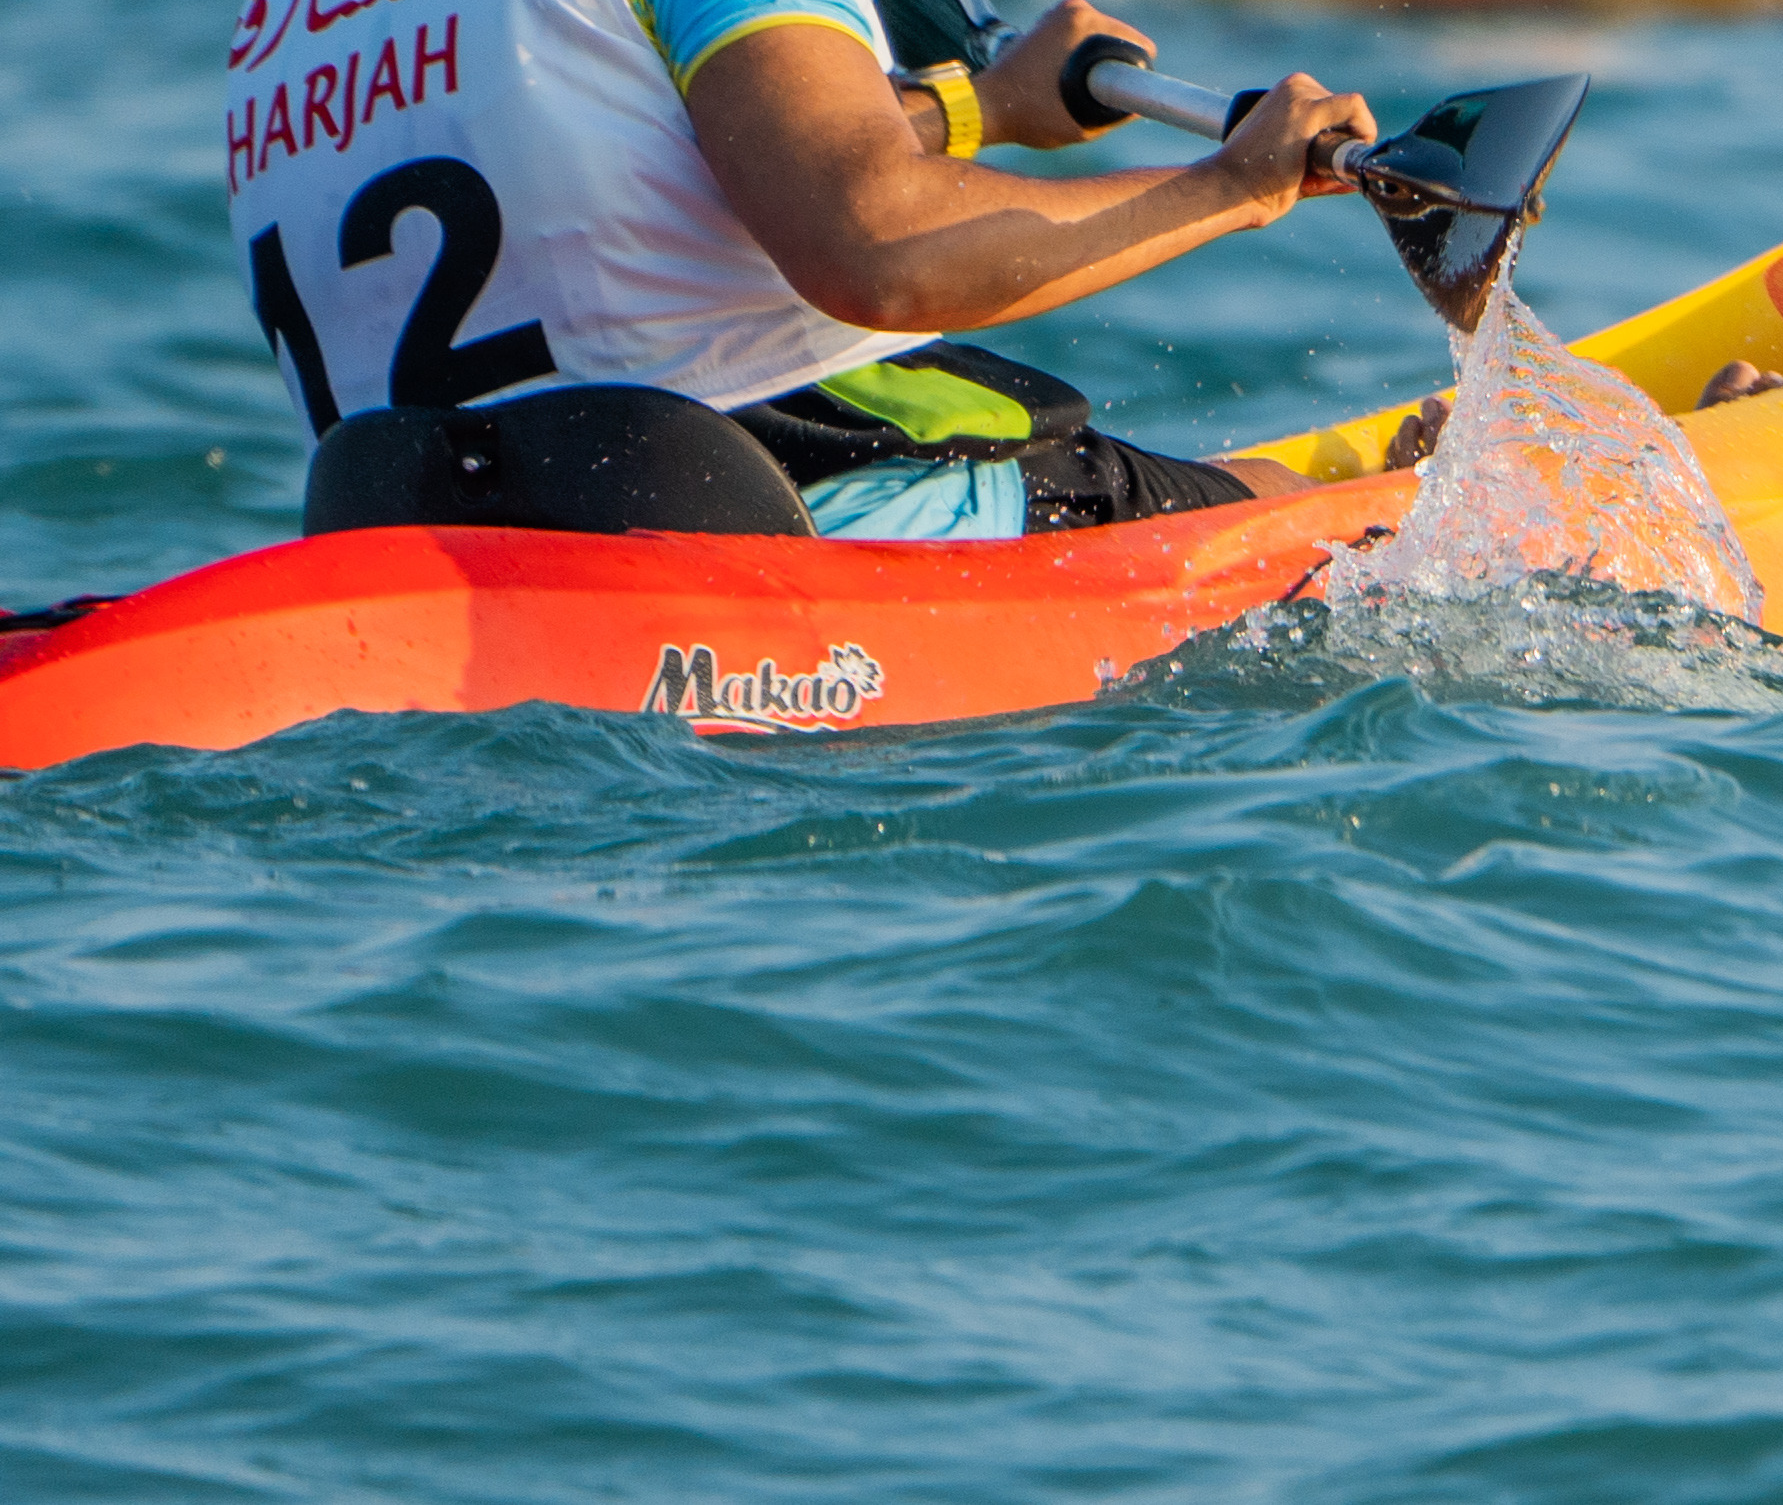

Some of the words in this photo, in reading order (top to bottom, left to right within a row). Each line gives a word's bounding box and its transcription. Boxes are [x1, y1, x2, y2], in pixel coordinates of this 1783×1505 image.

[226, 11, 459, 196] HARJAH
[249, 161, 559, 442] 12
[640, 643, 863, 718] Makao
